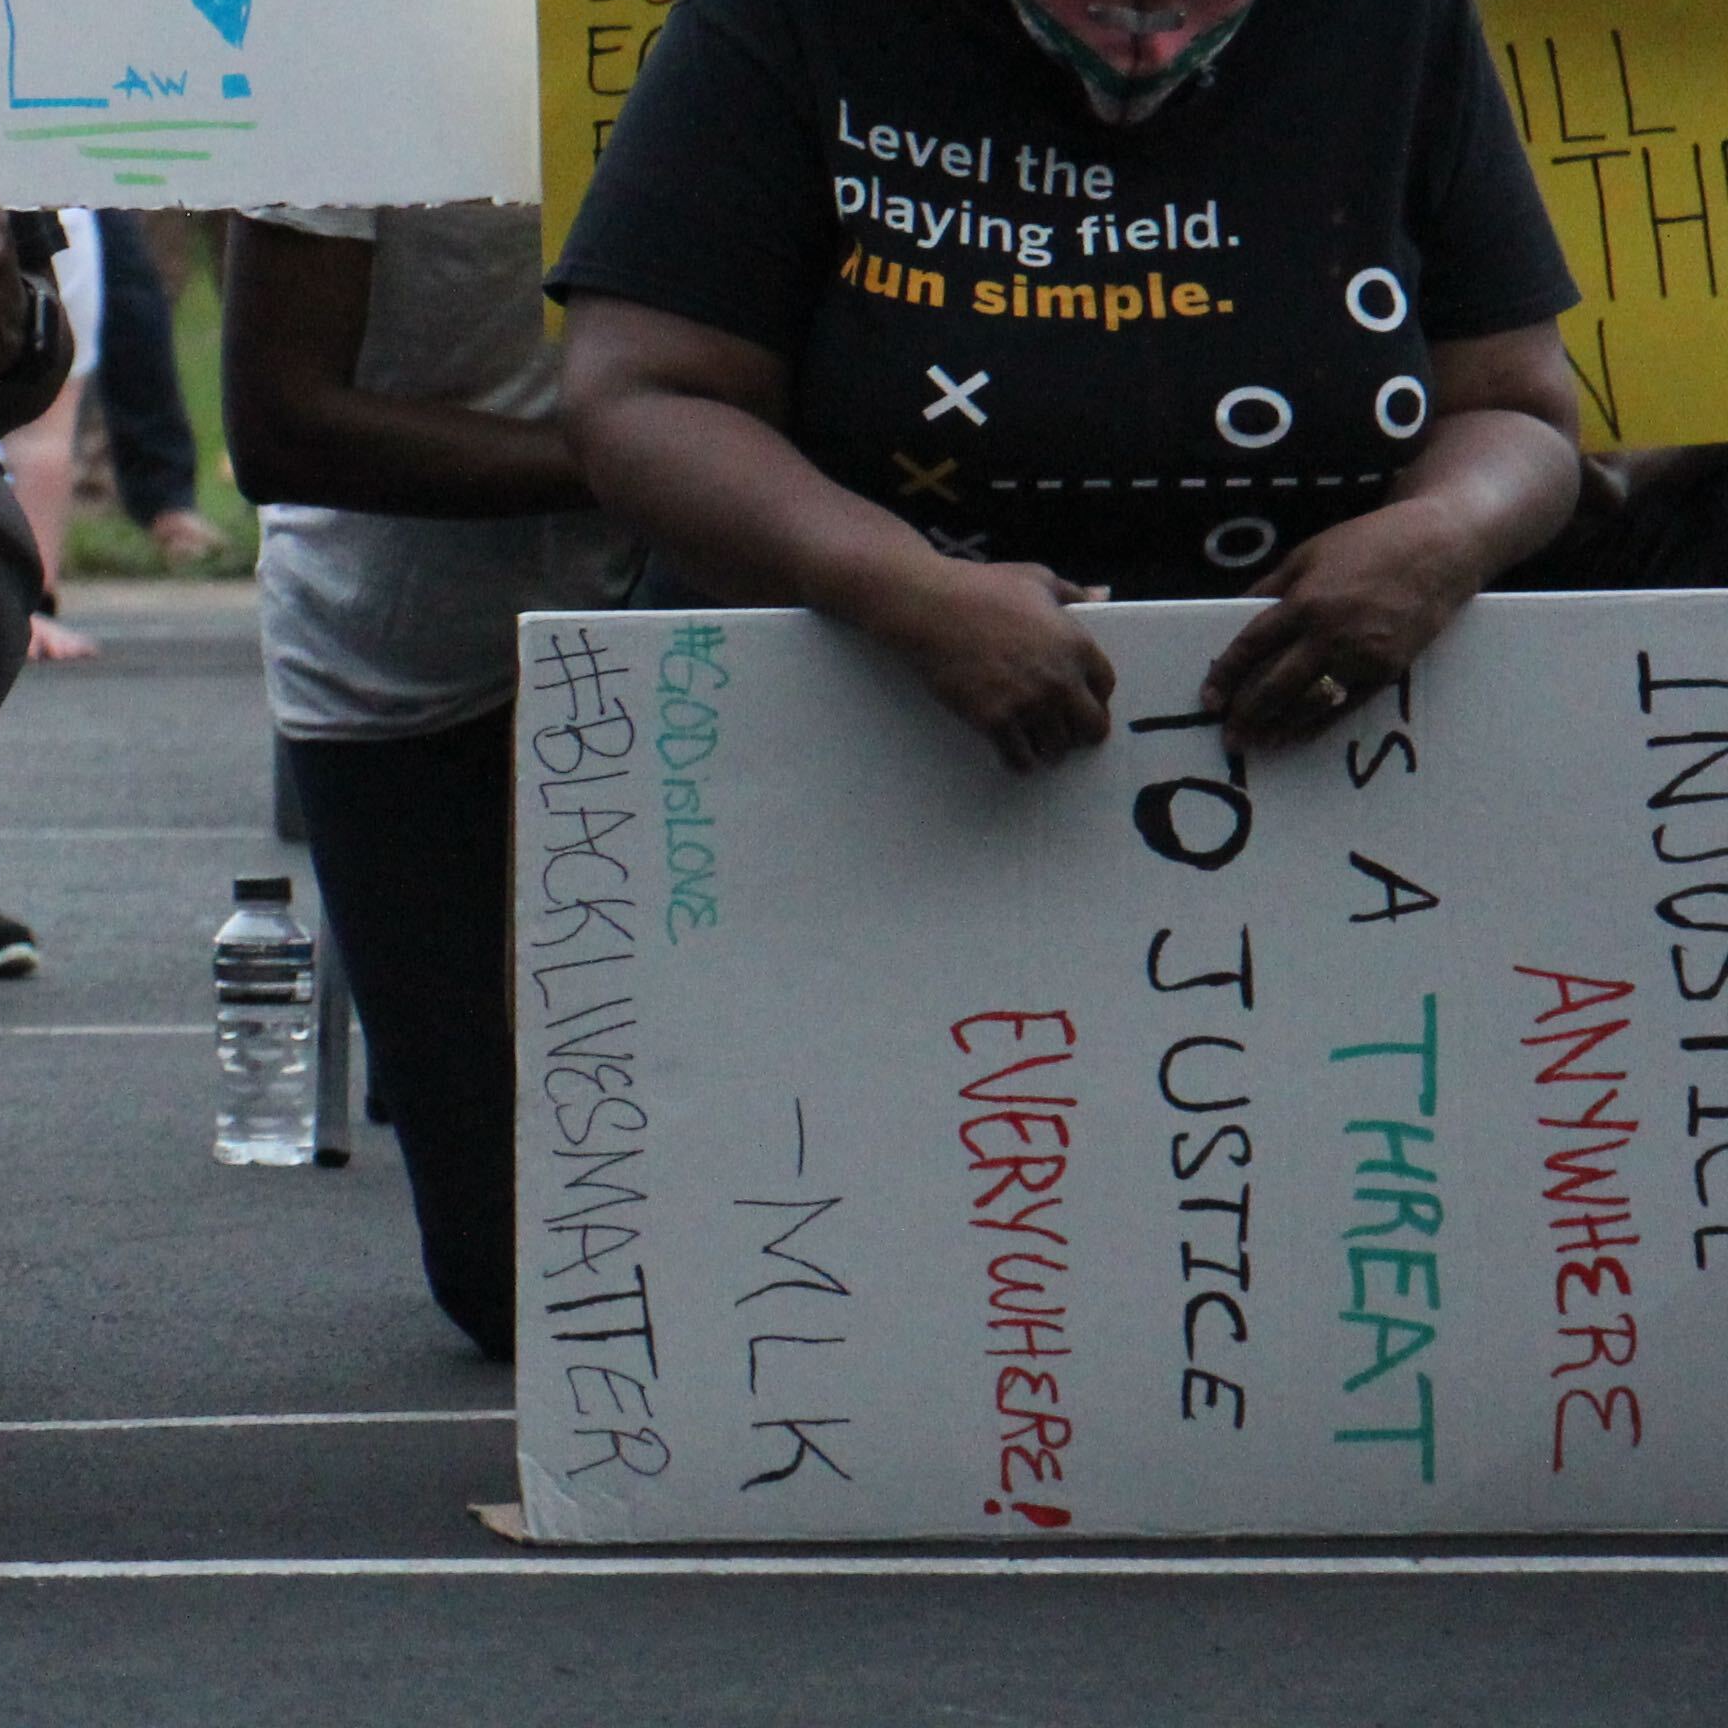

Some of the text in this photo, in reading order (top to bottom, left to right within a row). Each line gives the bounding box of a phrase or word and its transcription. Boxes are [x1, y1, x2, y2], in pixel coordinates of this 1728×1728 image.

[834, 174, 1240, 268] playing field.
[838, 98, 1115, 201] Level the
[972, 272, 1234, 332] simple.
[529, 627, 674, 1485] #BLACKLIVESMATTER
[1347, 851, 1440, 925] A
[949, 1009, 1078, 1530] EVERYWHERE!
[1146, 923, 1255, 1433] JUSTICE
[1329, 993, 1446, 1485] THREAT
[1512, 963, 1643, 1475] ANYWHERE
